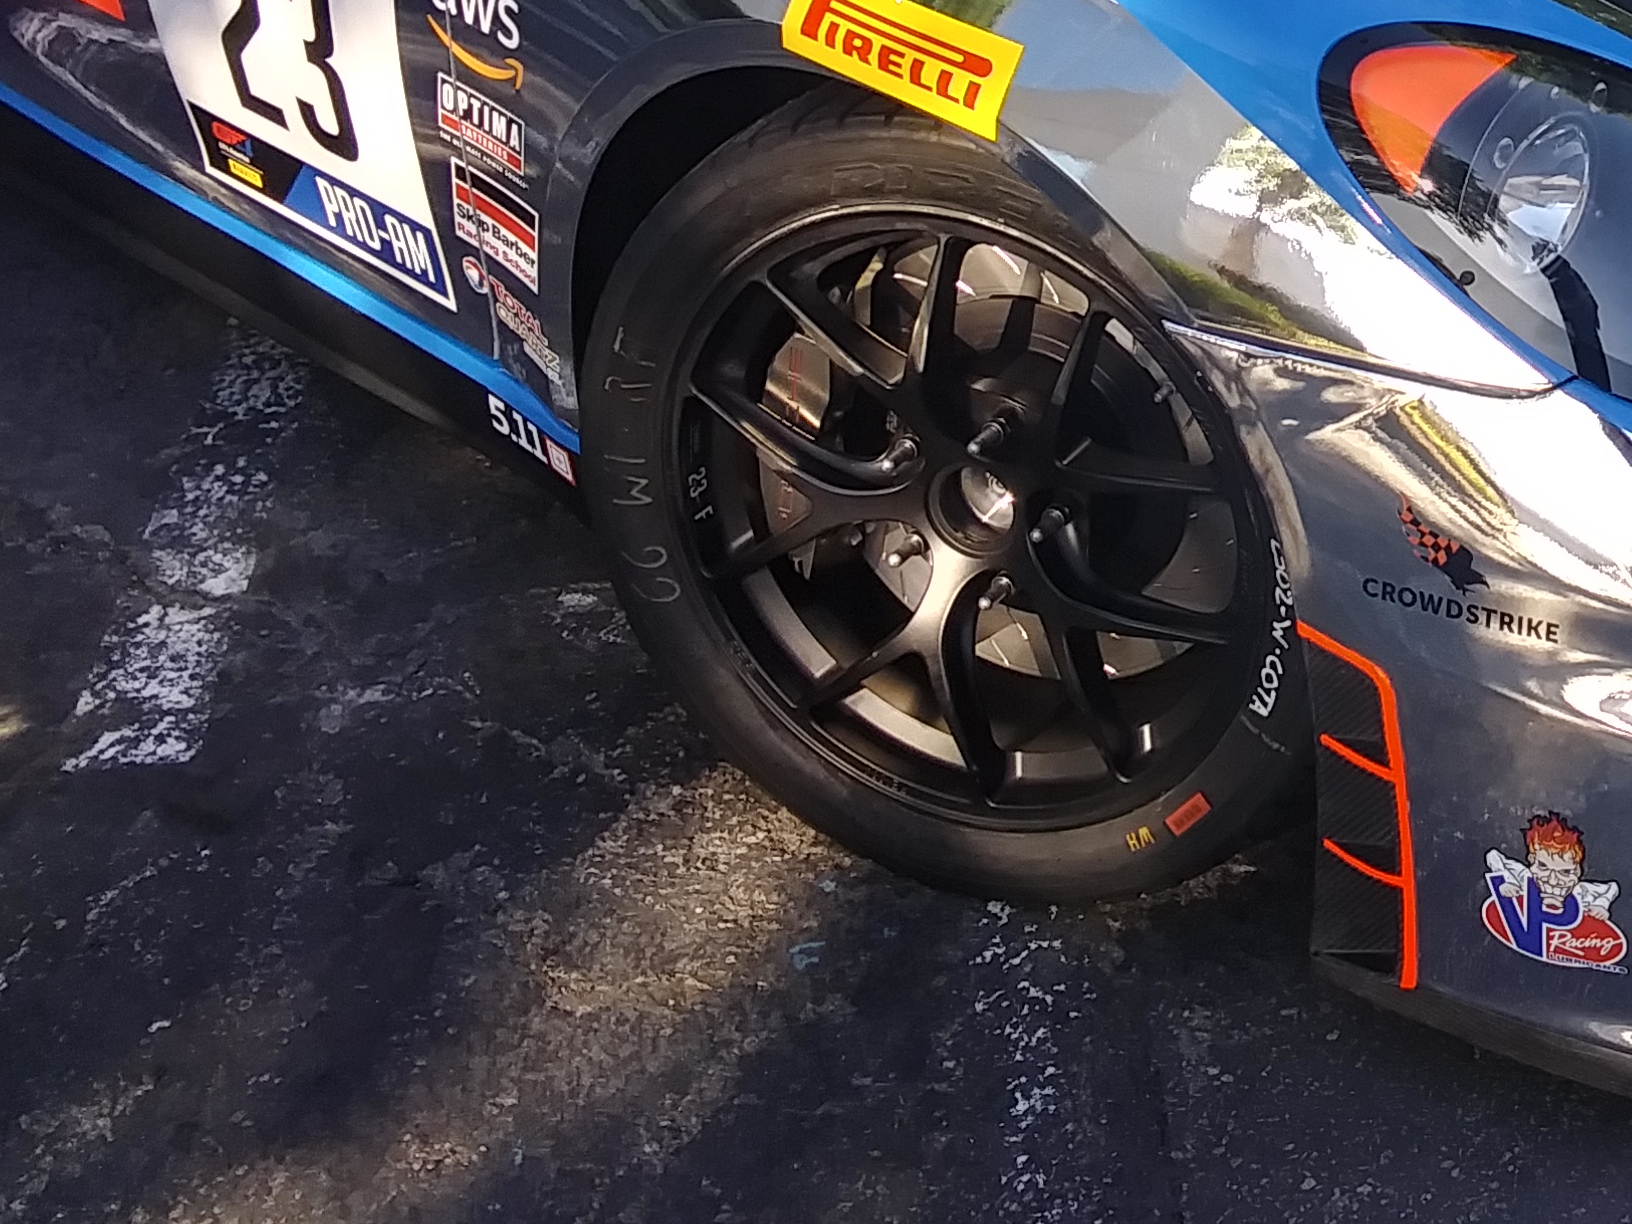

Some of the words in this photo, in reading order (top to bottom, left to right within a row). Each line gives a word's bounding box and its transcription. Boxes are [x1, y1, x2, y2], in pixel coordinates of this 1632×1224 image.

[442, 83, 521, 152] OPTIMA
[315, 175, 436, 283] PRO-AM
[456, 203, 490, 233] Skip
[491, 228, 535, 269] Barber
[457, 222, 500, 257] Racing
[502, 252, 536, 286] School
[488, 394, 548, 464] 5.11
[1362, 577, 1561, 646] CROWDSTRIKE
[1488, 874, 1582, 958] VP
[1549, 931, 1623, 956] Racing
